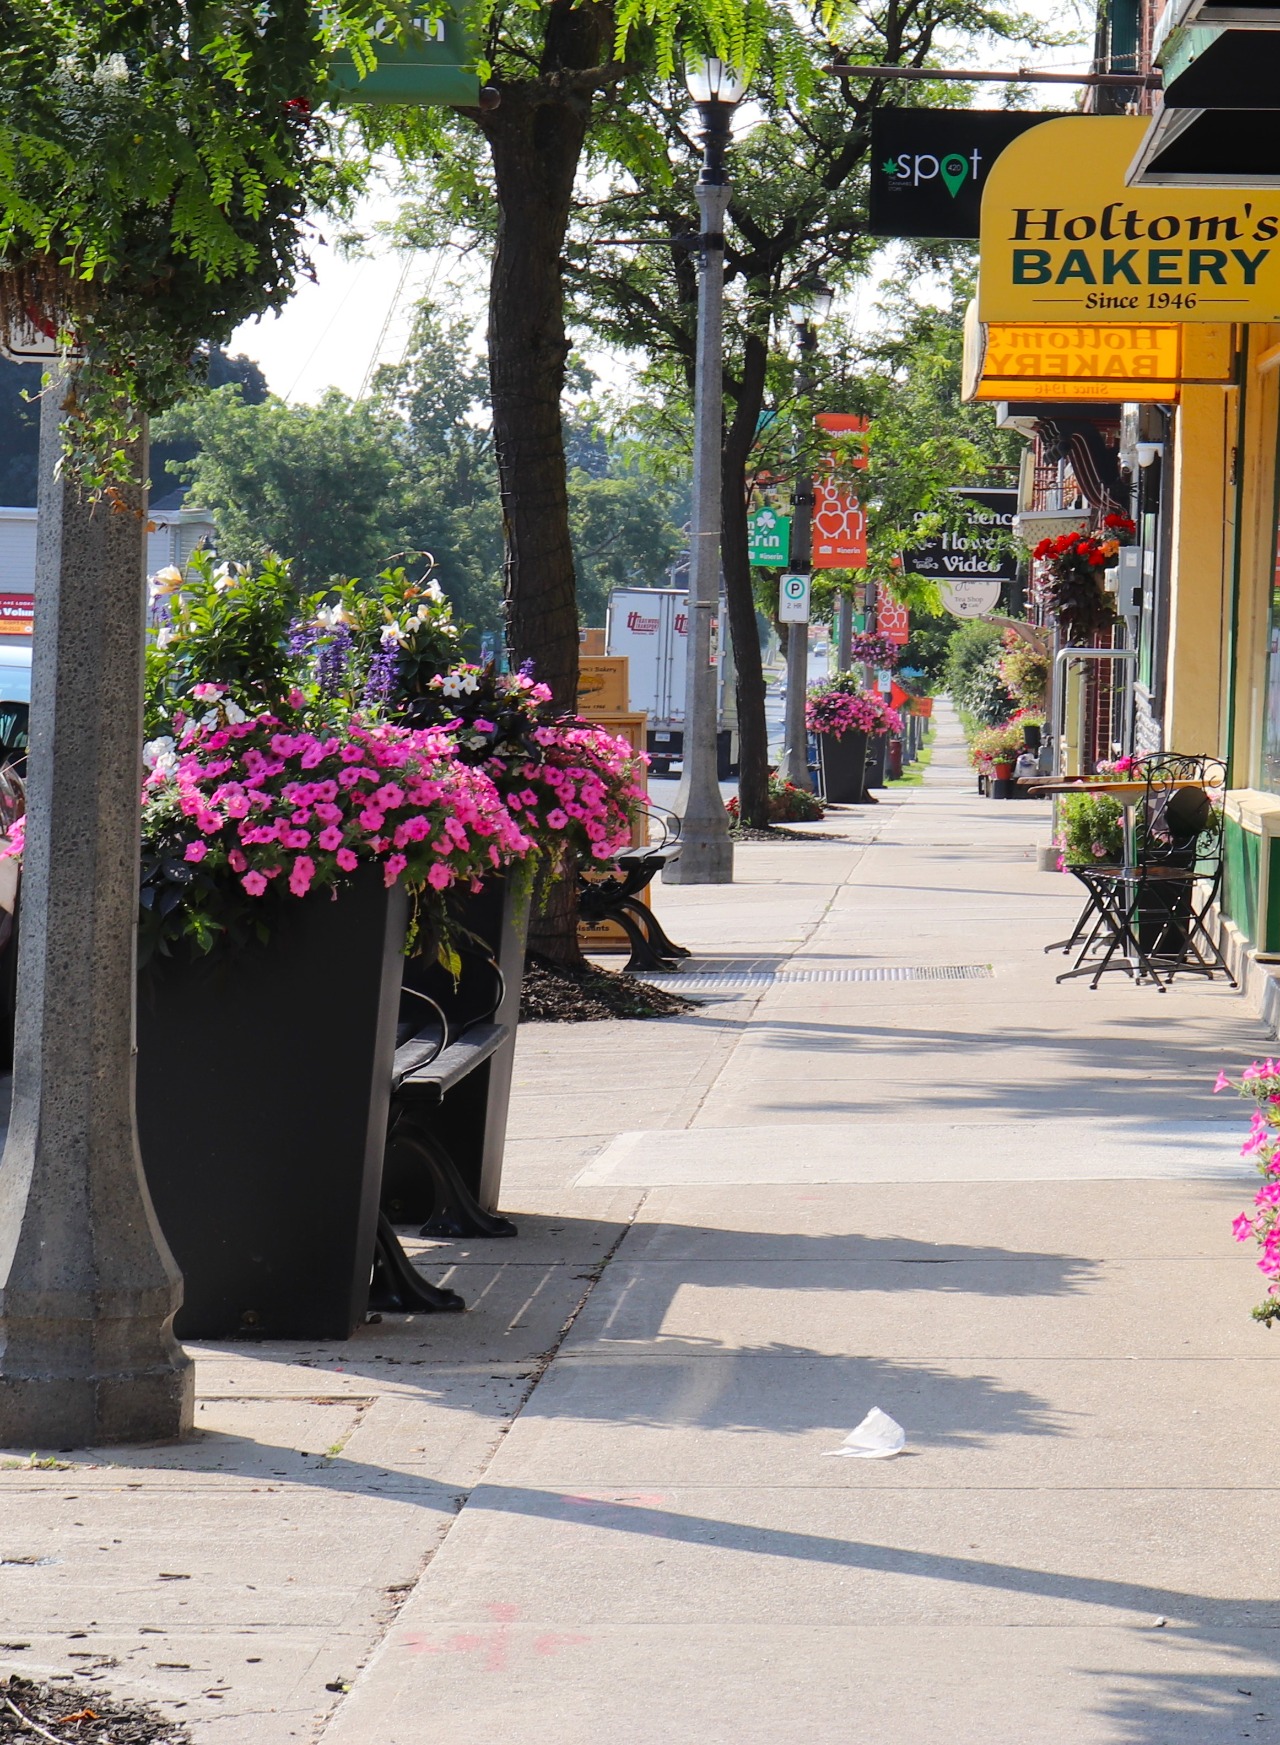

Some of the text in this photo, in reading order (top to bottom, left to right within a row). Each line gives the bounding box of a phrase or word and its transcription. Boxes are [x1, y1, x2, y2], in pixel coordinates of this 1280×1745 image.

[897, 148, 982, 187] spot
[1008, 203, 1279, 242] Holtom's
[1012, 249, 1271, 285] BAKERY
[1085, 293, 1197, 309] Since 1946
[942, 555, 1003, 573] Video
[791, 583, 800, 594] P
